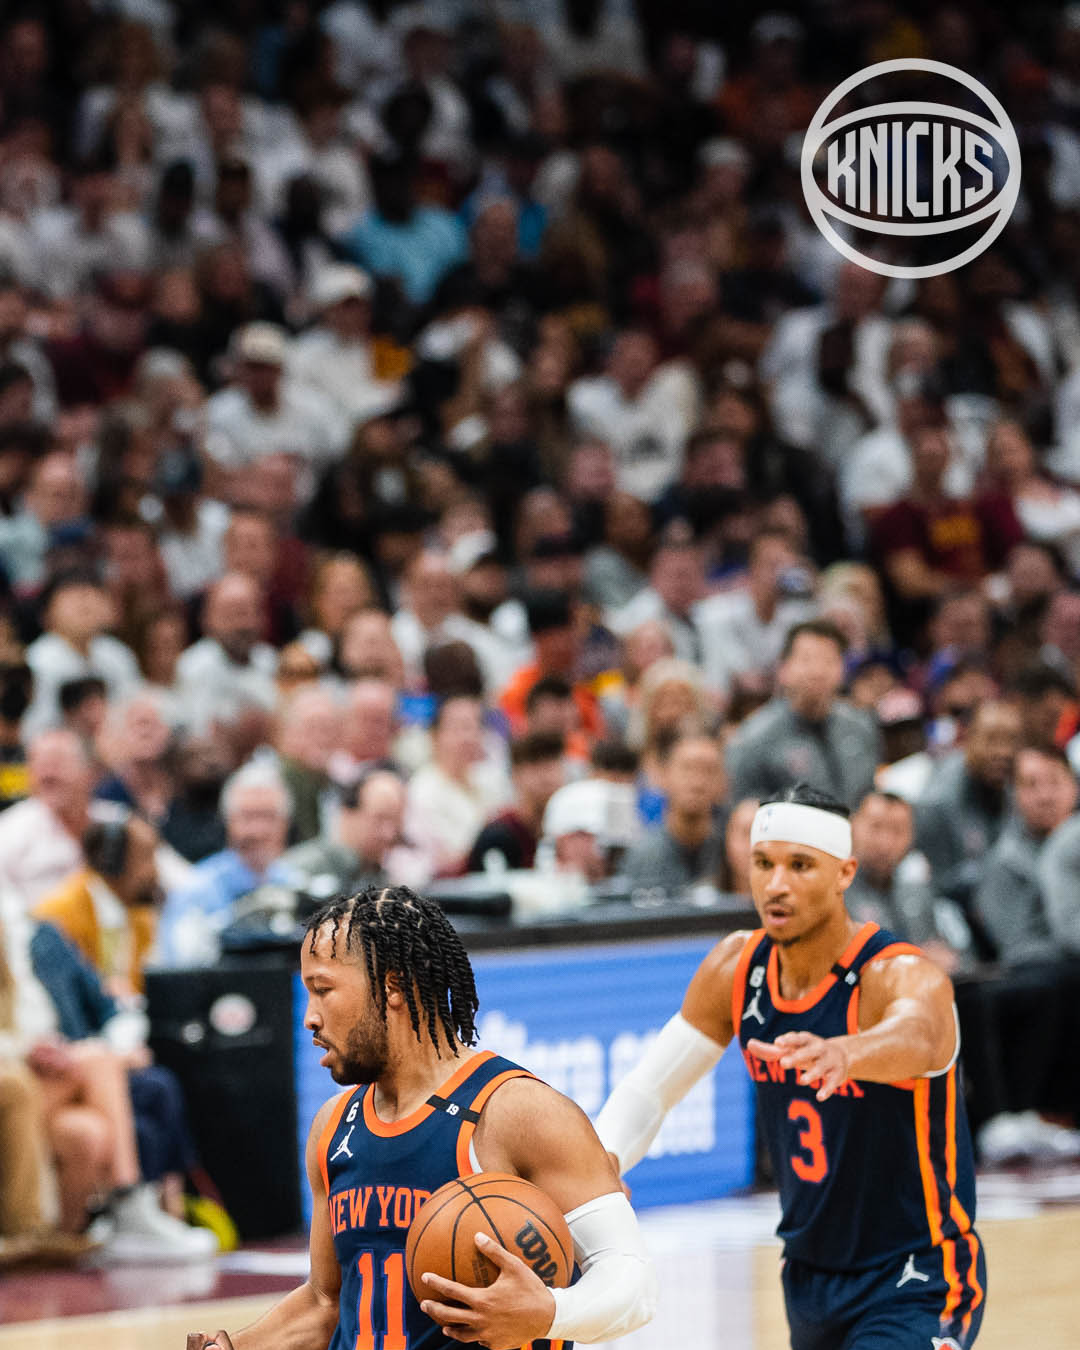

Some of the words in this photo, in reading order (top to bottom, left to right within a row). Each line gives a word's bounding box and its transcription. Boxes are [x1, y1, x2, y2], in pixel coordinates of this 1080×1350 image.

[749, 966, 766, 988] 6
[345, 1101, 360, 1123] 6
[446, 1103, 460, 1116] 19
[787, 1099, 828, 1183] 3
[329, 1186, 373, 1236] NEW
